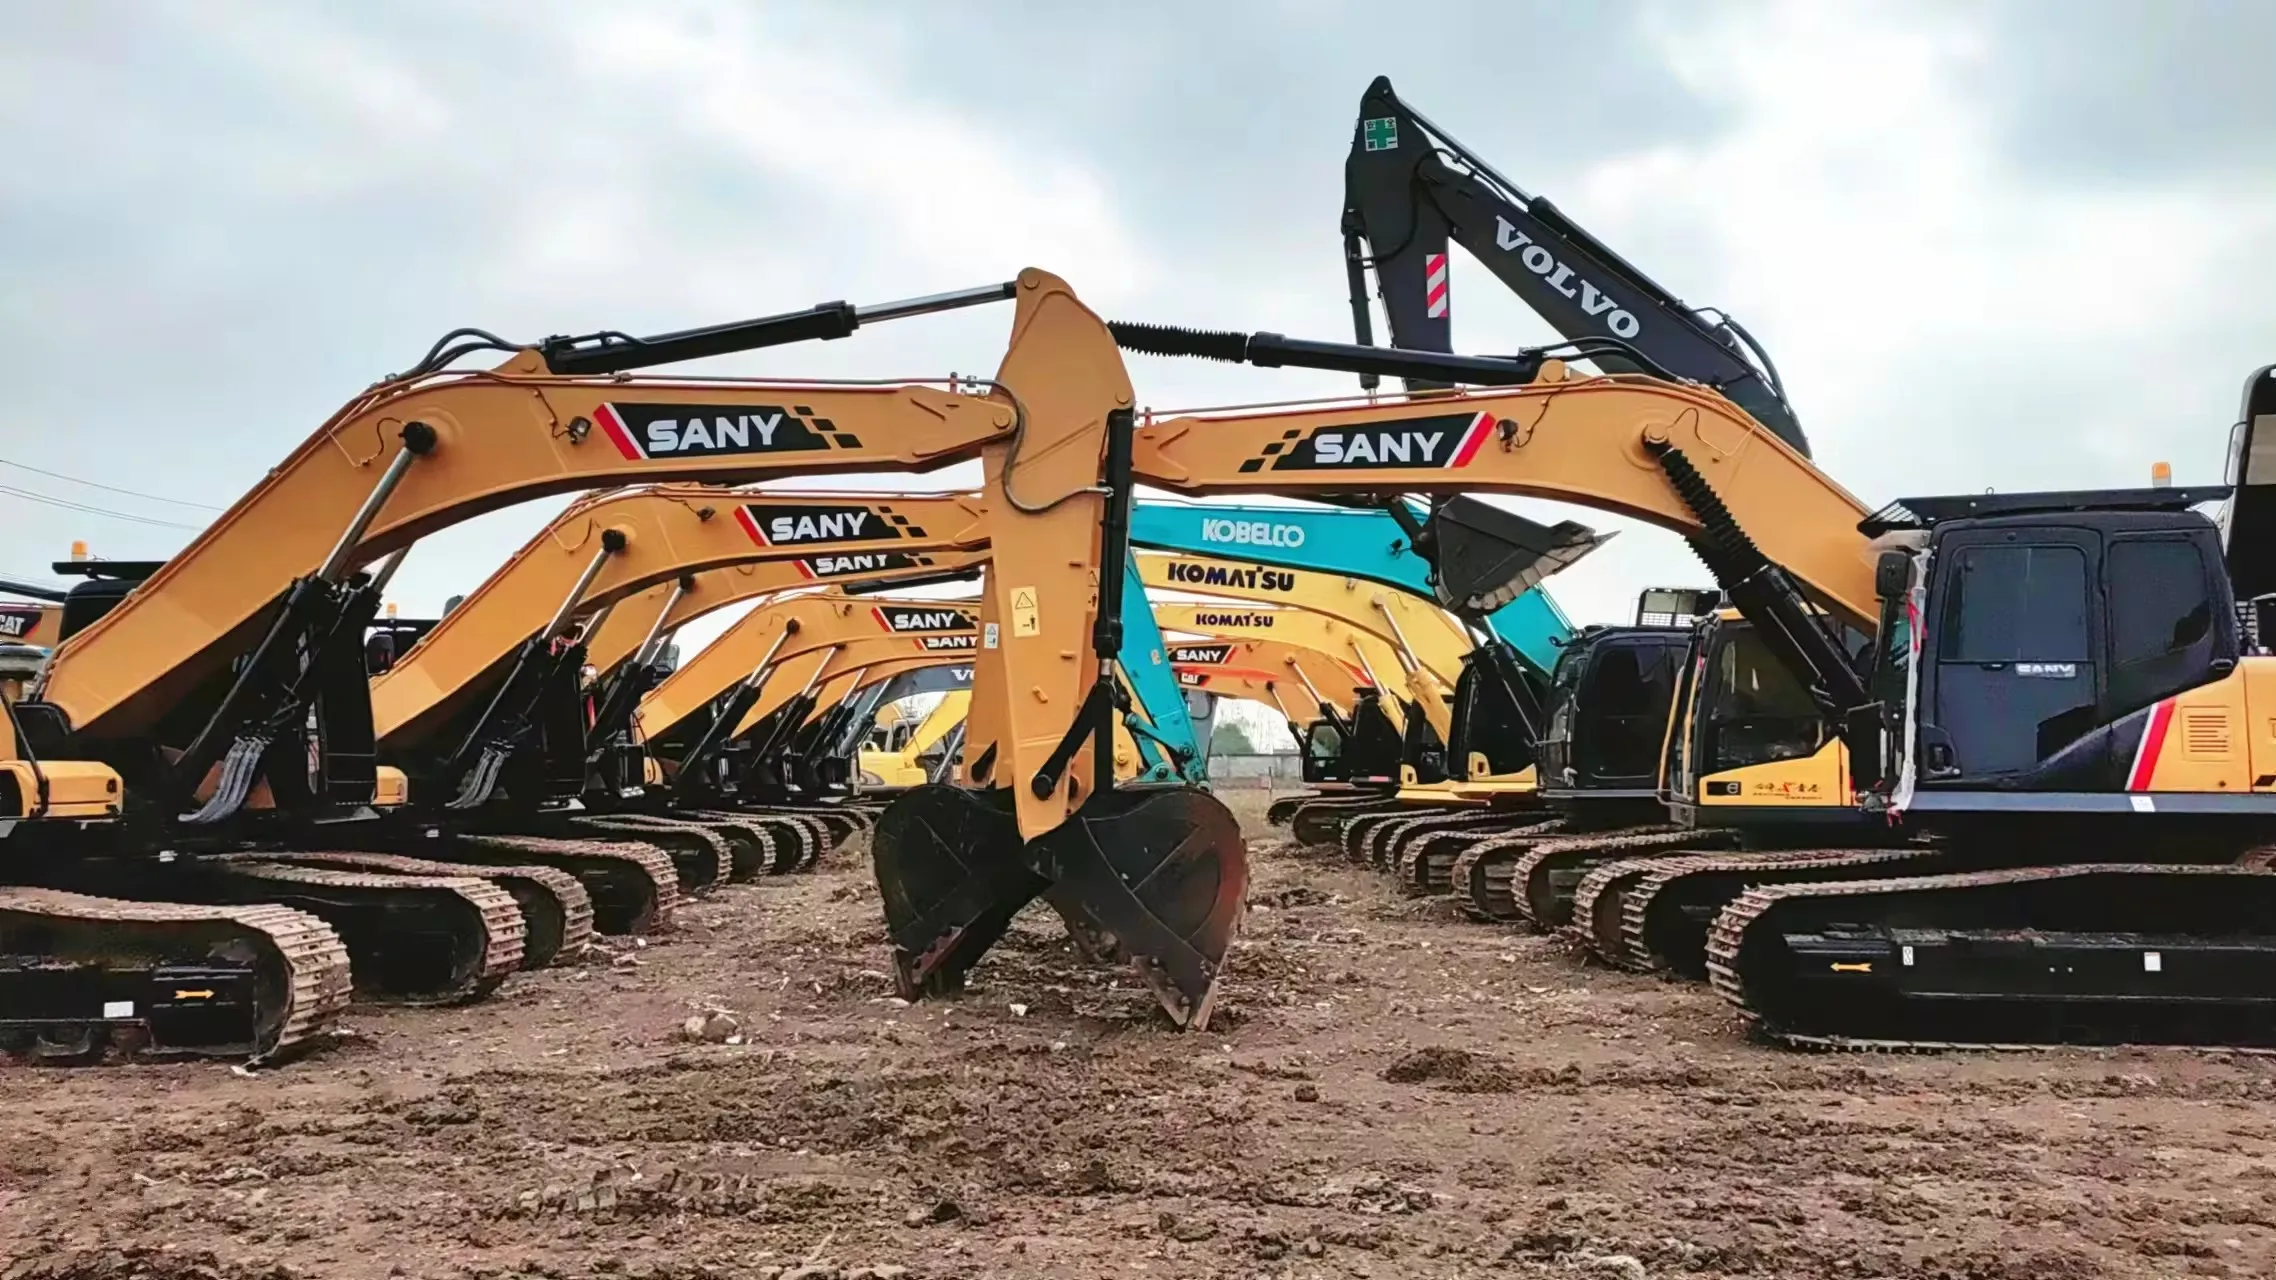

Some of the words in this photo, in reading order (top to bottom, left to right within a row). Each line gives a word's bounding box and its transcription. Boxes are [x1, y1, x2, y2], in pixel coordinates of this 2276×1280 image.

[1496, 215, 1640, 338] VOLVO
[648, 414, 783, 452] SANY
[1315, 432, 1444, 463] SANY
[772, 511, 868, 541] SANY
[1203, 519, 1305, 548] KOBELCO
[816, 554, 888, 574] SANY
[1167, 562, 1295, 592] KOMATSU
[894, 612, 955, 630] SANY
[1195, 613, 1274, 628] KOMATSU
[926, 636, 979, 648] SANY
[1177, 649, 1221, 661] SANY
